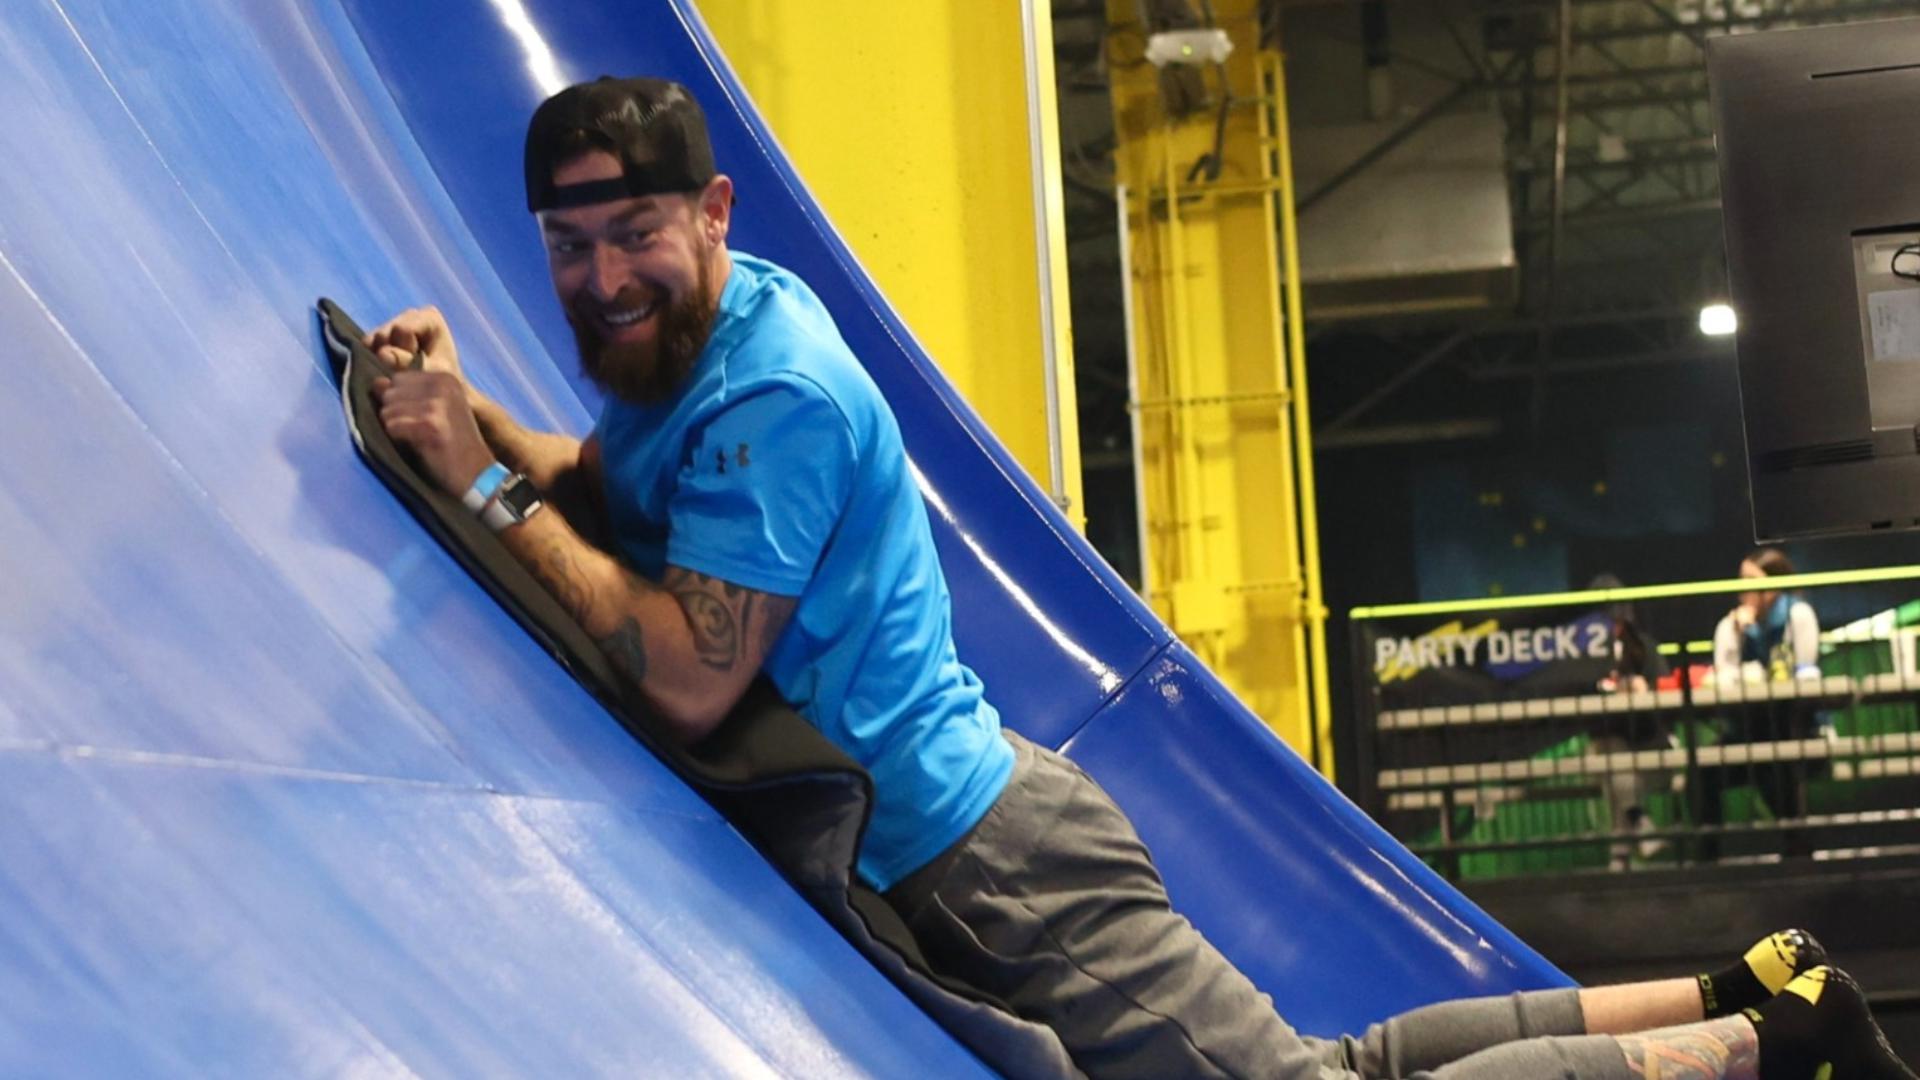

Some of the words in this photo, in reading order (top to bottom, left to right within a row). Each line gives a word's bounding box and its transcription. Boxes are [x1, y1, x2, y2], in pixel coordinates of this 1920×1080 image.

[1375, 632, 1481, 670] PARTY
[1487, 626, 1580, 664] DECK
[1586, 622, 1609, 657] 2
